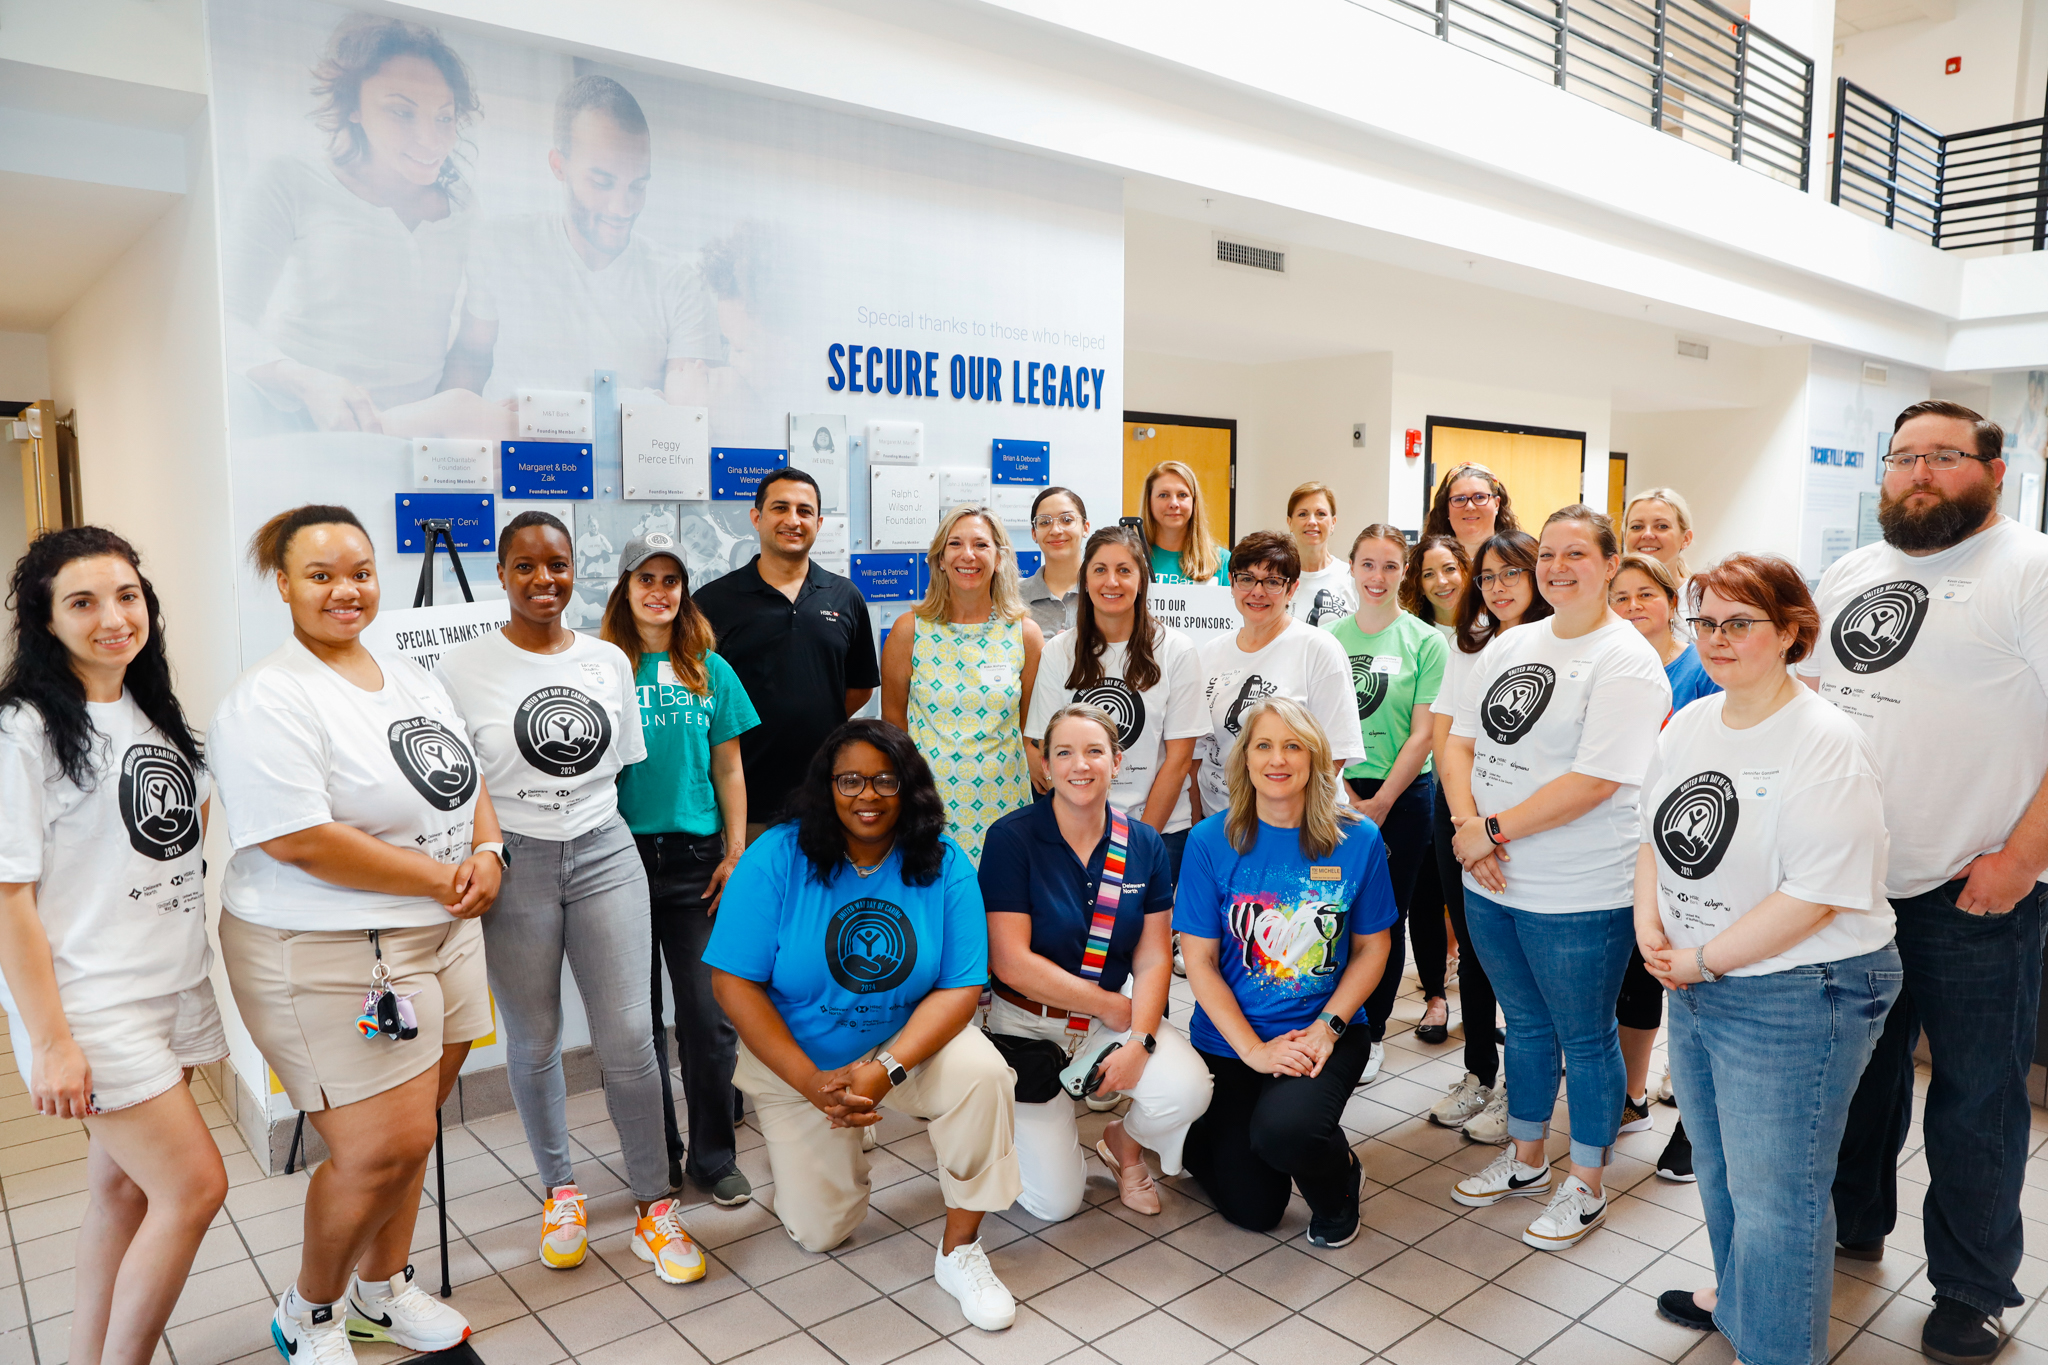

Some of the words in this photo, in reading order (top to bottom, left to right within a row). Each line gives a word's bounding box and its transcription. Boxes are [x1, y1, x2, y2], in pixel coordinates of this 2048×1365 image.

[857, 306, 914, 328] Special
[919, 313, 968, 335] thanks
[972, 320, 986, 336] to
[990, 322, 1028, 341] those
[1032, 328, 1060, 345] who
[1064, 330, 1105, 351] helped
[827, 343, 939, 398] SECURE
[950, 354, 1002, 402] OUR
[1013, 360, 1105, 410] LEGACY
[651, 439, 681, 451] Peggy
[638, 454, 667, 464] Pierce
[669, 454, 694, 465] Elfvin
[518, 463, 554, 472] Margaret
[728, 466, 742, 474] Gina
[749, 467, 774, 475] Michael
[541, 474, 556, 482] Zak
[740, 476, 762, 484] Weiner
[891, 490, 912, 498] Ralph
[914, 490, 920, 498] C.
[888, 503, 913, 512] Wilson
[915, 504, 923, 512] Jr.
[458, 518, 478, 526] Cervi
[885, 516, 926, 525] Foundation
[1862, 587, 1884, 600] UNITED
[1885, 584, 1897, 592] WAY
[1897, 582, 1909, 590] DAY
[1154, 599, 1165, 610] TO
[1168, 600, 1186, 611] OUR
[1184, 616, 1234, 630] SPONSORS:
[396, 628, 439, 650] SPECIAL
[440, 623, 479, 644] THANKS
[1508, 667, 1526, 676] UNITED
[1853, 662, 1868, 672] 2024
[1263, 681, 1278, 694] '23
[522, 696, 538, 712] UNITED
[537, 690, 550, 700] WAY
[563, 688, 570, 696] OF
[570, 691, 590, 705] CARING
[659, 685, 713, 710] Bank
[412, 719, 420, 727] OF
[640, 712, 710, 727] UNTEER
[144, 747, 152, 756] OF
[154, 748, 178, 762] CARING
[560, 766, 576, 774] 2024
[1680, 778, 1698, 792] UNITED
[1698, 774, 1710, 783] WAY
[1710, 774, 1720, 783] DAY
[1718, 778, 1726, 786] OF
[449, 796, 460, 808] 2024
[164, 844, 182, 857] 2024
[1681, 866, 1693, 876] 2024
[143, 883, 162, 891] Delaware
[837, 907, 855, 921] UNITED
[854, 902, 866, 910] WAY
[884, 905, 902, 919] CARING
[861, 984, 876, 992] 2024
